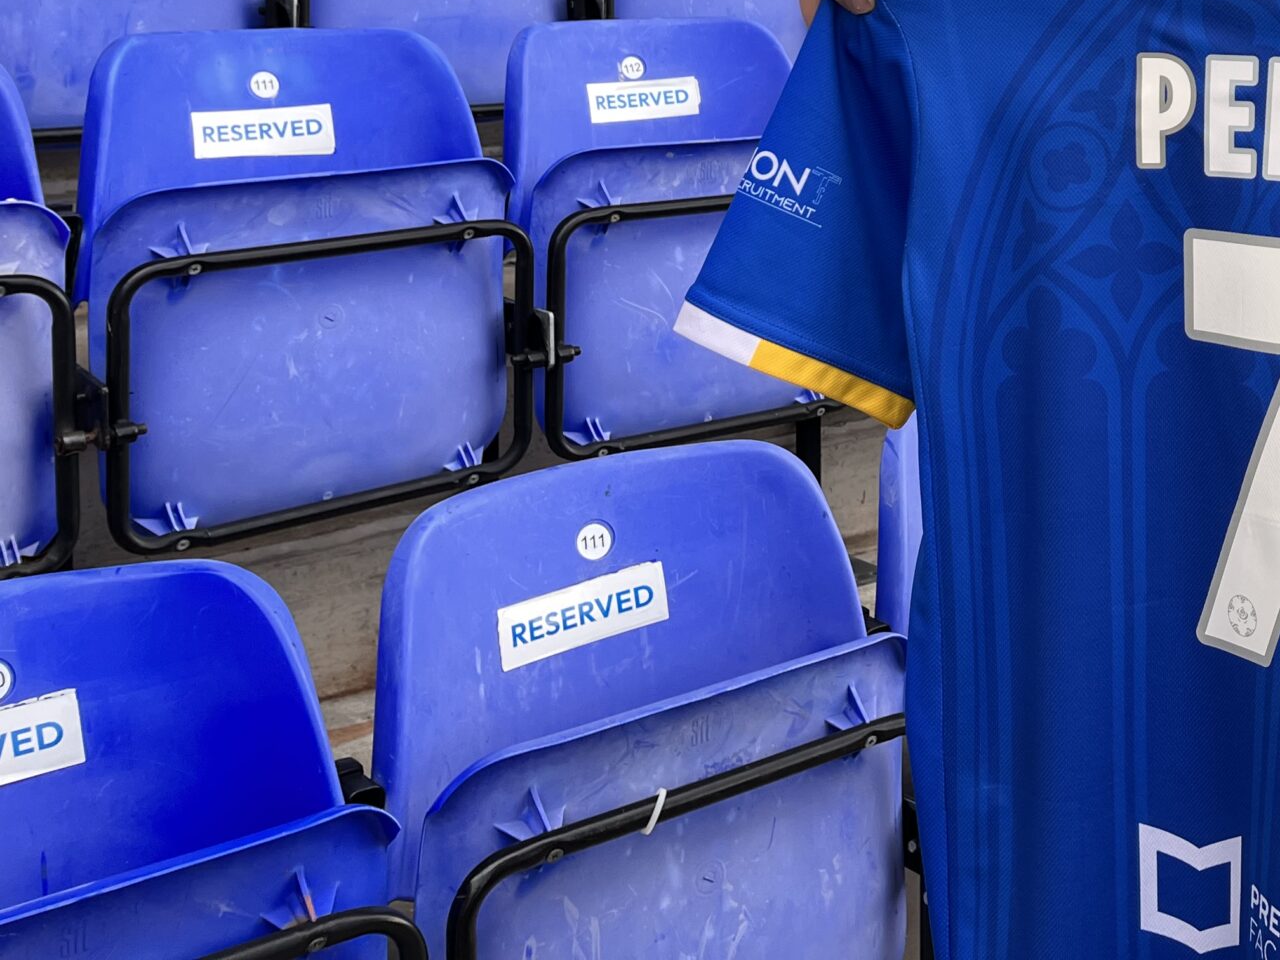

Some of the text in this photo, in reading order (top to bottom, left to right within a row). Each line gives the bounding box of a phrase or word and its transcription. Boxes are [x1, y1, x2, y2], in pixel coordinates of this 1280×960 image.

[623, 62, 642, 74] 112
[253, 79, 274, 91] 111
[595, 89, 689, 110] RESERVED
[202, 119, 323, 143] RESERVED
[580, 533, 606, 550] 111
[511, 584, 654, 648] RESERVED
